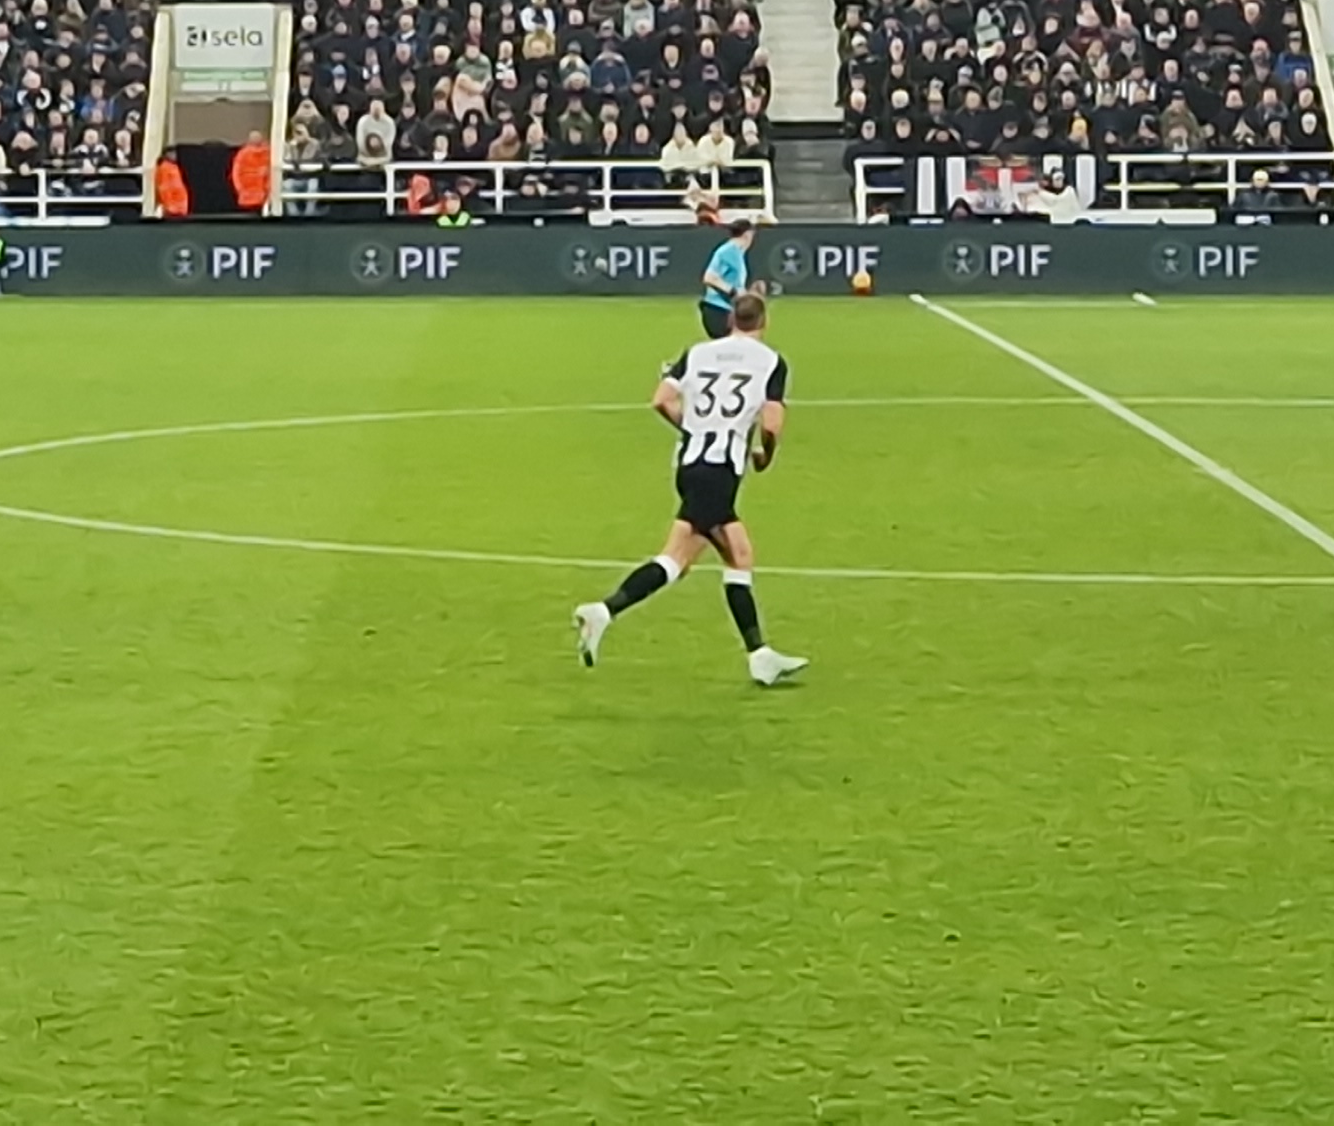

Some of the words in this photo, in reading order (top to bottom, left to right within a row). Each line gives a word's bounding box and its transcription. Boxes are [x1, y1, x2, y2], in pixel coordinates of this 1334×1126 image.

[212, 26, 263, 46] sela
[3, 247, 62, 278] PIF
[213, 246, 275, 279] PIF
[398, 246, 461, 279] PIF
[609, 246, 670, 278] PIF
[818, 245, 879, 277] PIF
[990, 244, 1051, 276] PIF
[1199, 245, 1259, 277] PIF
[694, 370, 752, 418] 33
